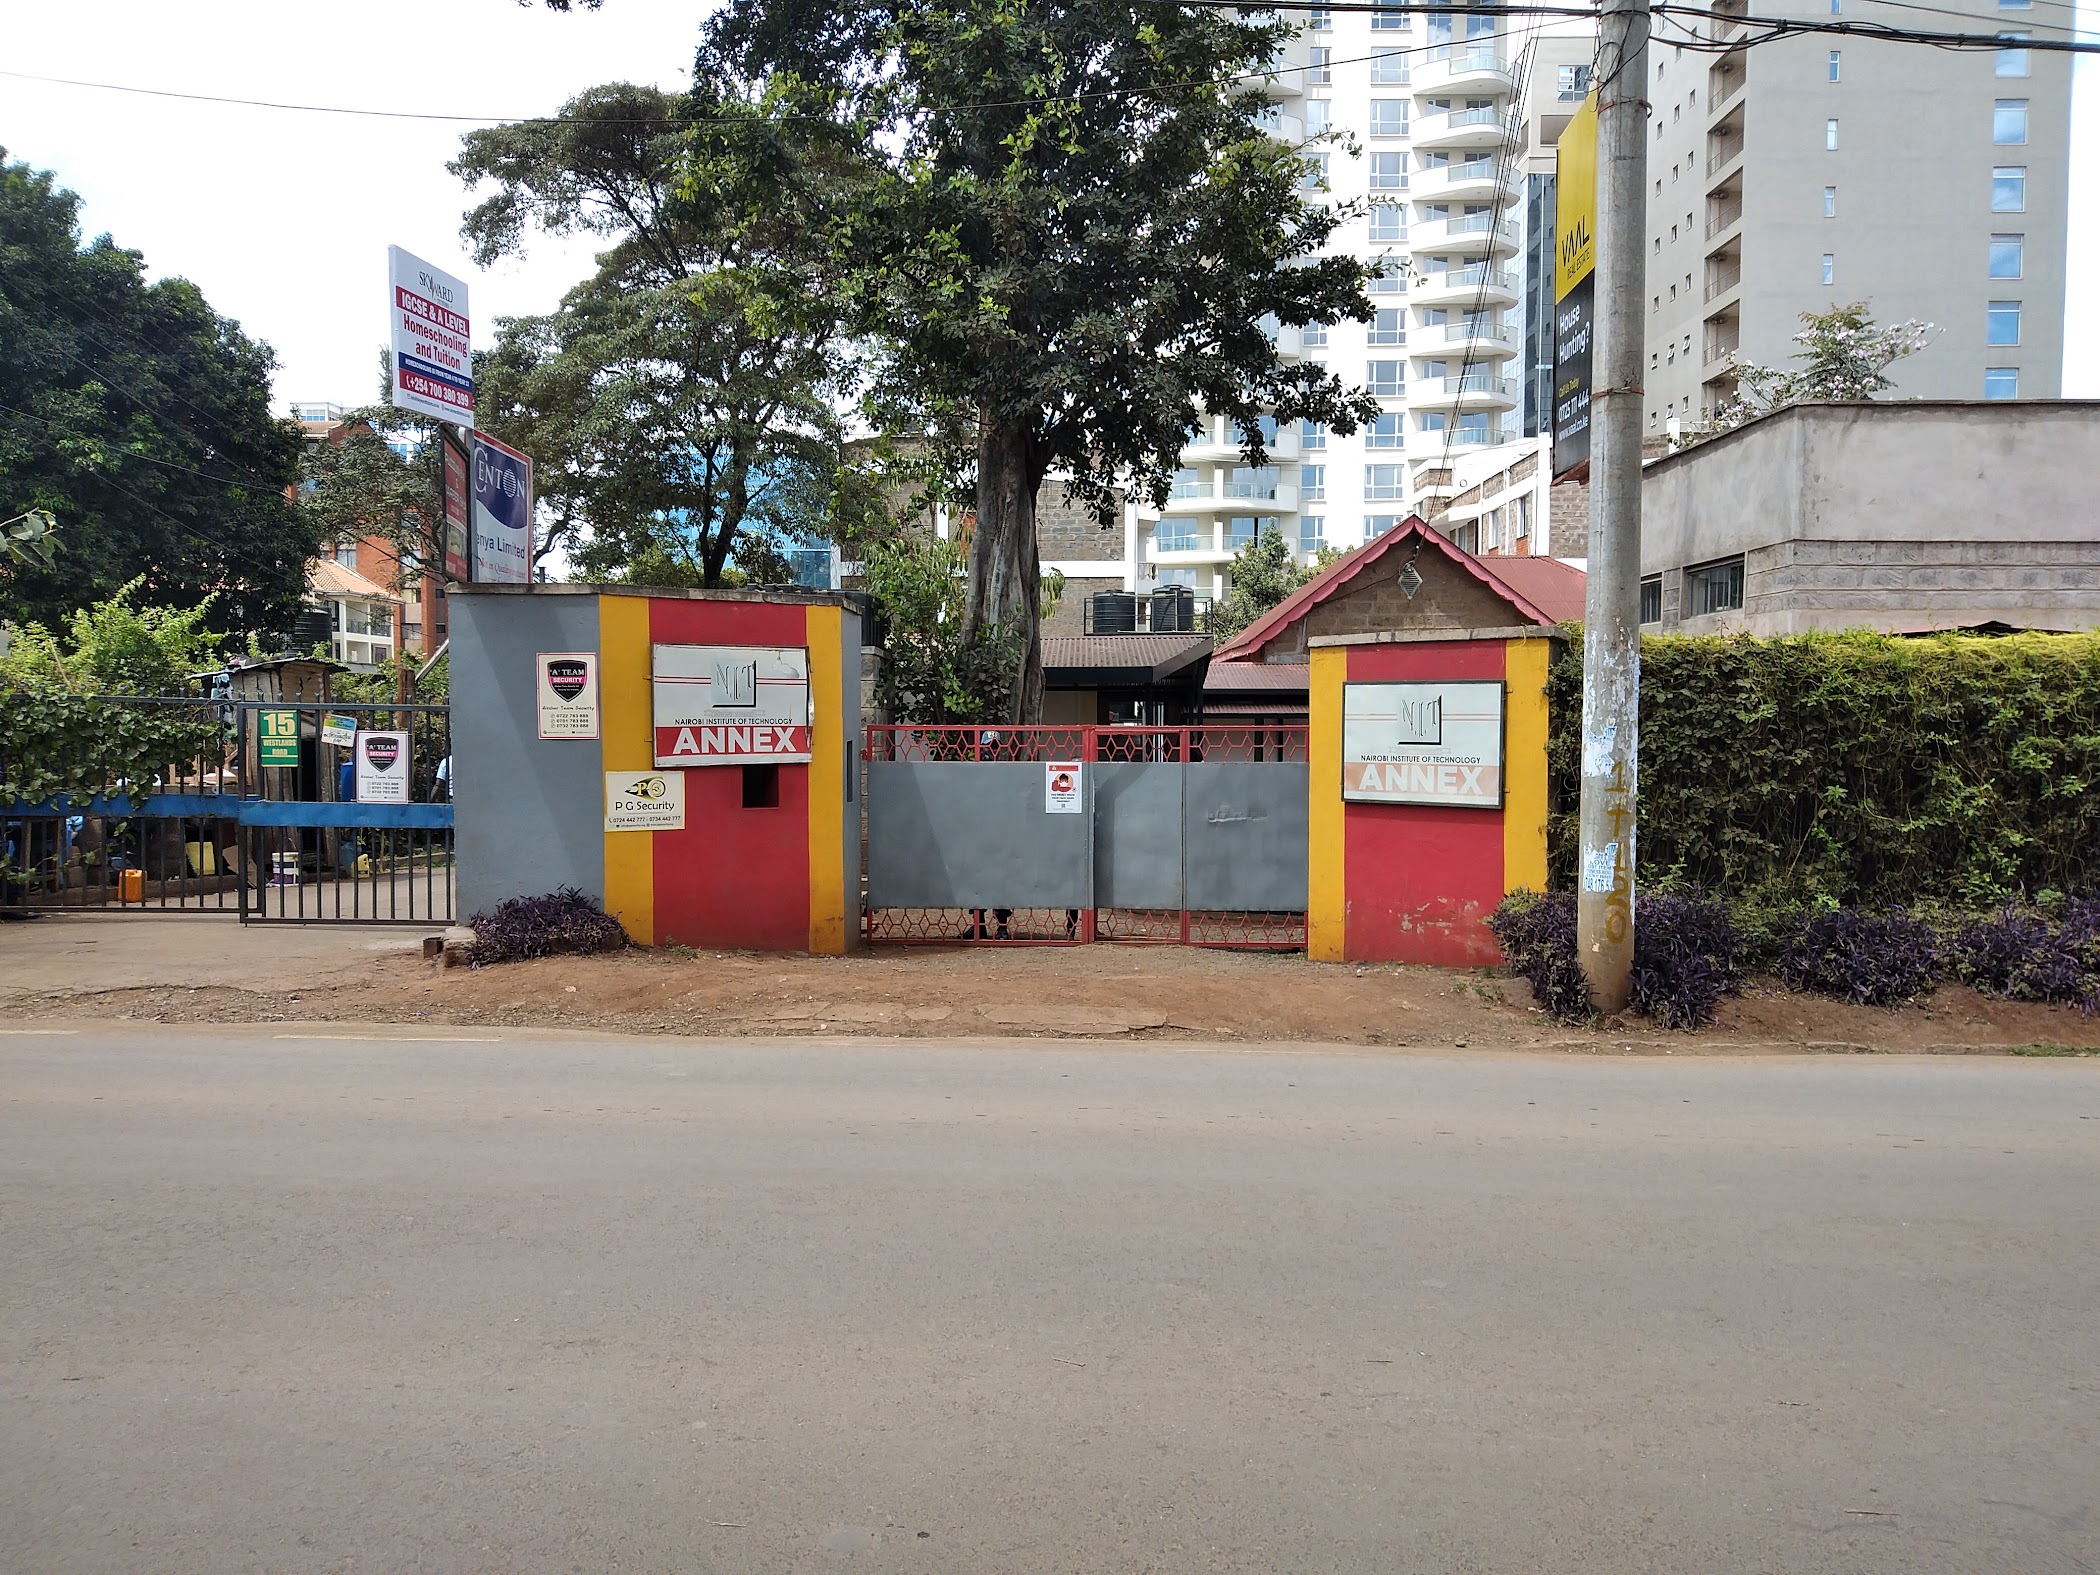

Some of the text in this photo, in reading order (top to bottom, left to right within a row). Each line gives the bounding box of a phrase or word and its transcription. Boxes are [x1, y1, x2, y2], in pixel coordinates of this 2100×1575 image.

[1562, 214, 1590, 267] VAAL
[1567, 247, 1590, 280] REAL ESTATE
[419, 271, 454, 303] SKYWARD
[402, 292, 428, 317] IGCSE
[429, 305, 436, 321] &
[437, 309, 444, 325] A
[445, 312, 468, 335] LEVEL
[1560, 304, 1580, 337] House
[403, 313, 467, 358] Homeschooling
[1560, 321, 1590, 366] Hunting?
[416, 342, 460, 370] and Tuition
[410, 377, 428, 394] +254
[429, 382, 442, 398] 700
[443, 387, 456, 403] 380
[457, 392, 469, 407] 399
[1578, 388, 1589, 410] 444
[497, 537, 525, 559] Limited
[263, 713, 295, 736] 15
[263, 739, 297, 747] WESTLANDS
[272, 748, 288, 756] ROAD
[672, 727, 797, 754] ANNEX
[1390, 755, 1420, 763] INSTITUTE
[1433, 756, 1481, 764] TECHNOLOGY
[1358, 764, 1483, 795] ANNEX
[615, 801, 675, 811] P G Security
